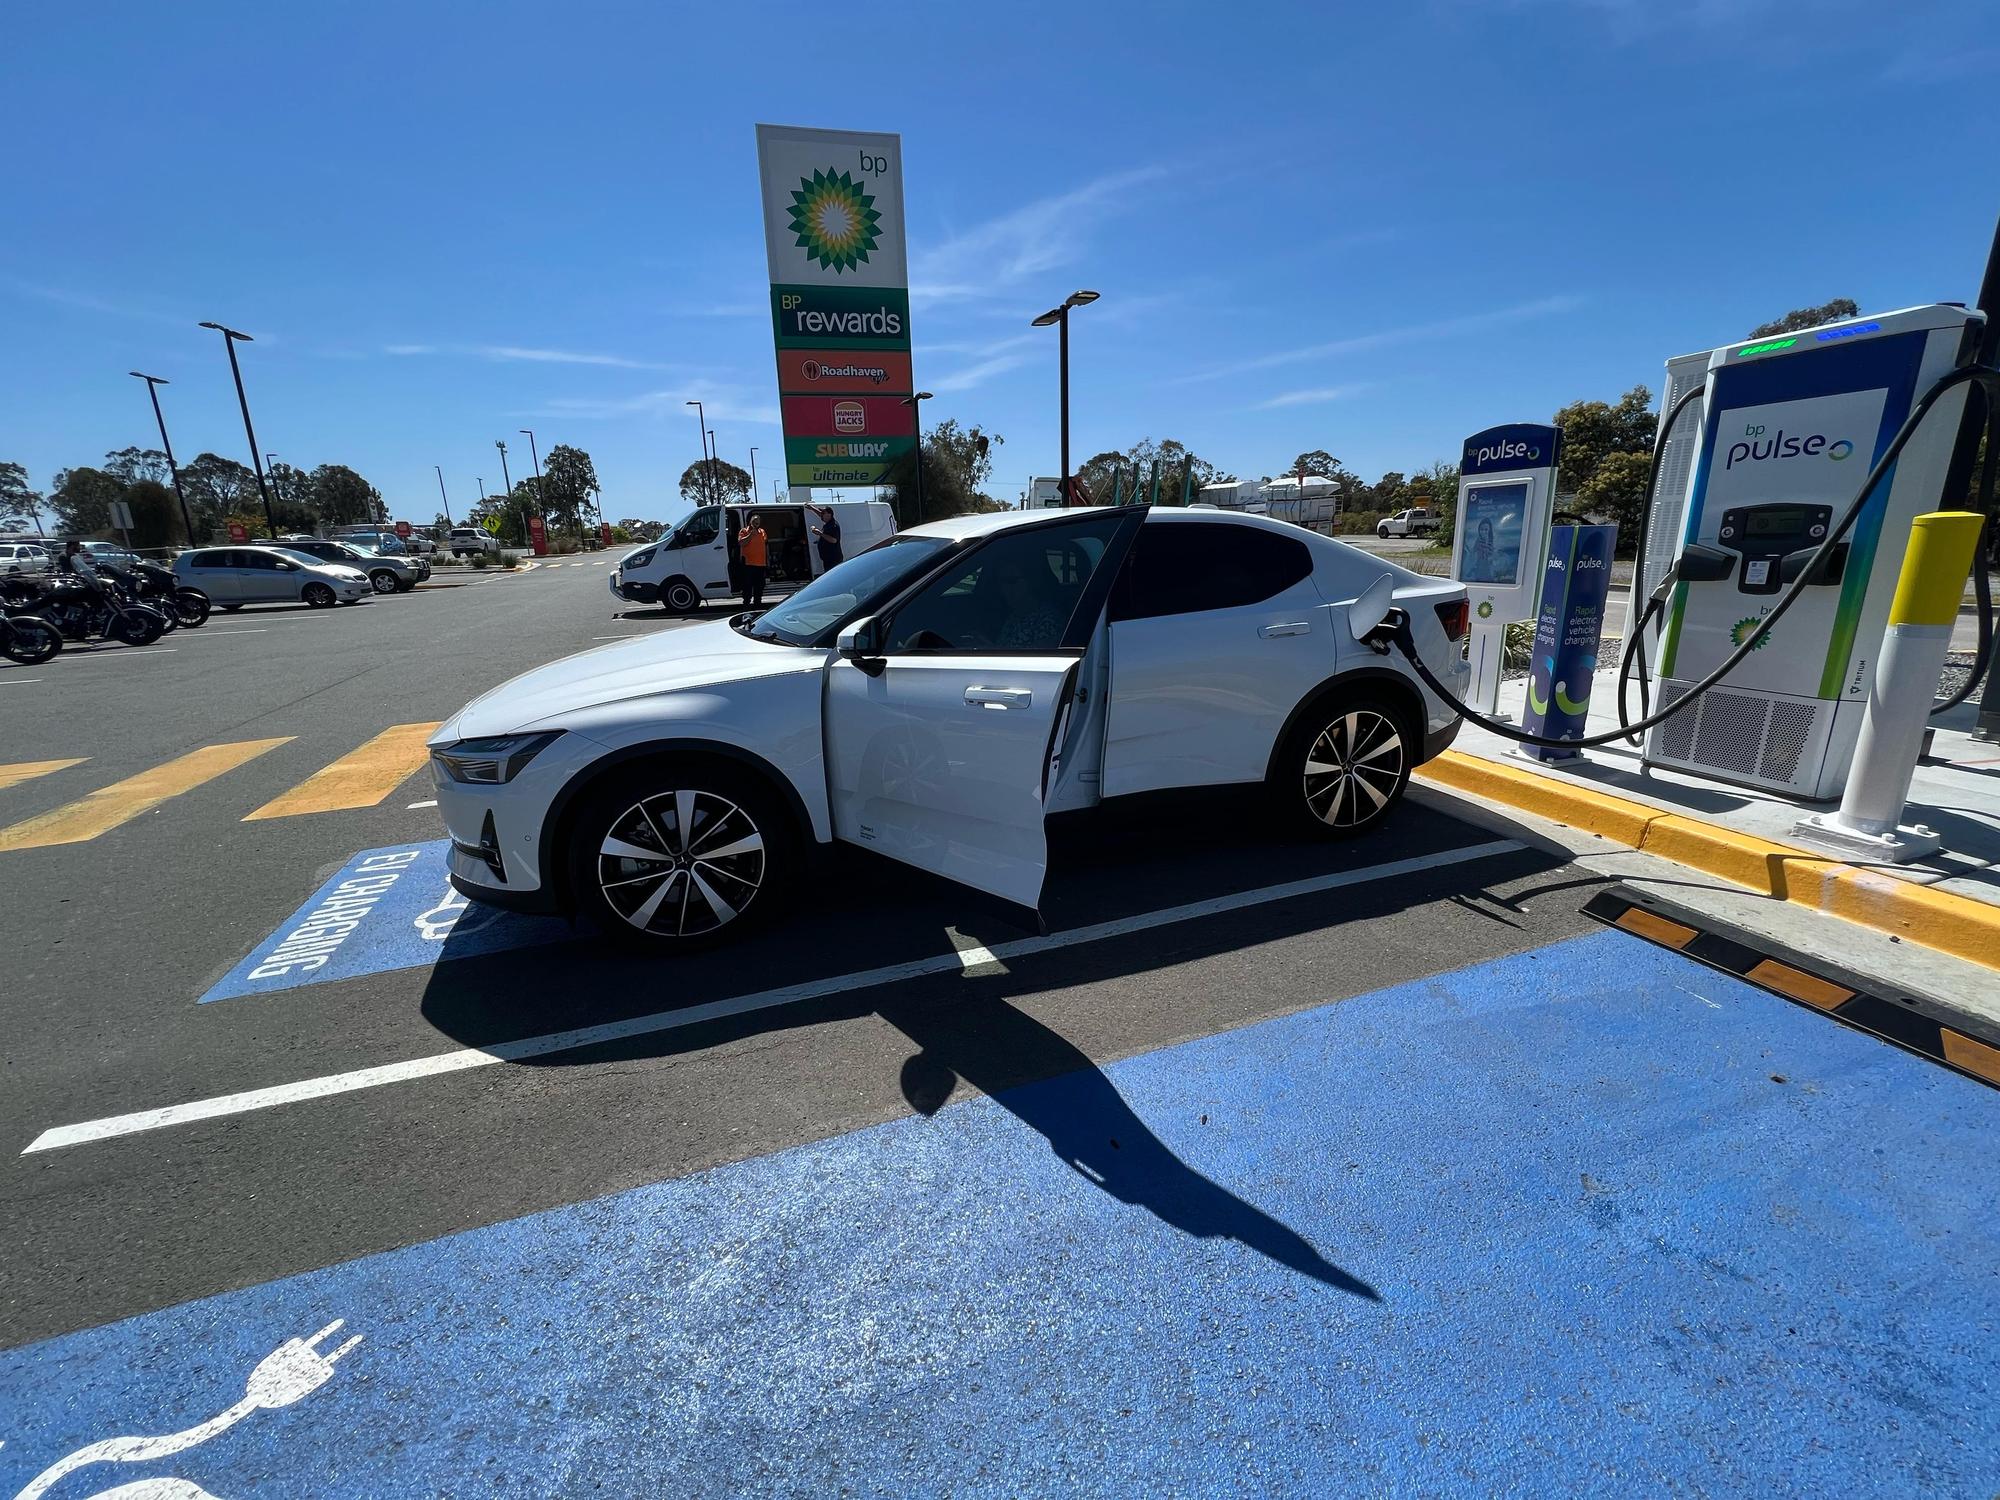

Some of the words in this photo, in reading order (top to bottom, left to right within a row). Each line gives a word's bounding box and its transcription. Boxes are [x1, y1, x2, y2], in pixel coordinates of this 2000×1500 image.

[860, 150, 888, 178] bp
[782, 294, 801, 310] BP
[797, 306, 901, 334] rewards
[821, 364, 884, 377] Roadhaven
[836, 410, 863, 418] HUNGRY
[837, 417, 863, 426] JACKS
[1745, 424, 1766, 438] bp
[816, 442, 889, 458] SUBWAY
[1467, 448, 1478, 457] bp
[1477, 439, 1527, 467] pulse
[1726, 430, 1826, 470] pulse
[813, 470, 869, 481] ultimate
[1576, 557, 1602, 571] pulse
[1575, 606, 1597, 617] Rapid
[1569, 617, 1598, 626] electric
[1569, 626, 1596, 636] vehicle
[1564, 636, 1597, 647] charging
[1854, 660, 1866, 685] TRITIUM
[355, 850, 420, 872] EV
[247, 873, 400, 980] CHARGING
